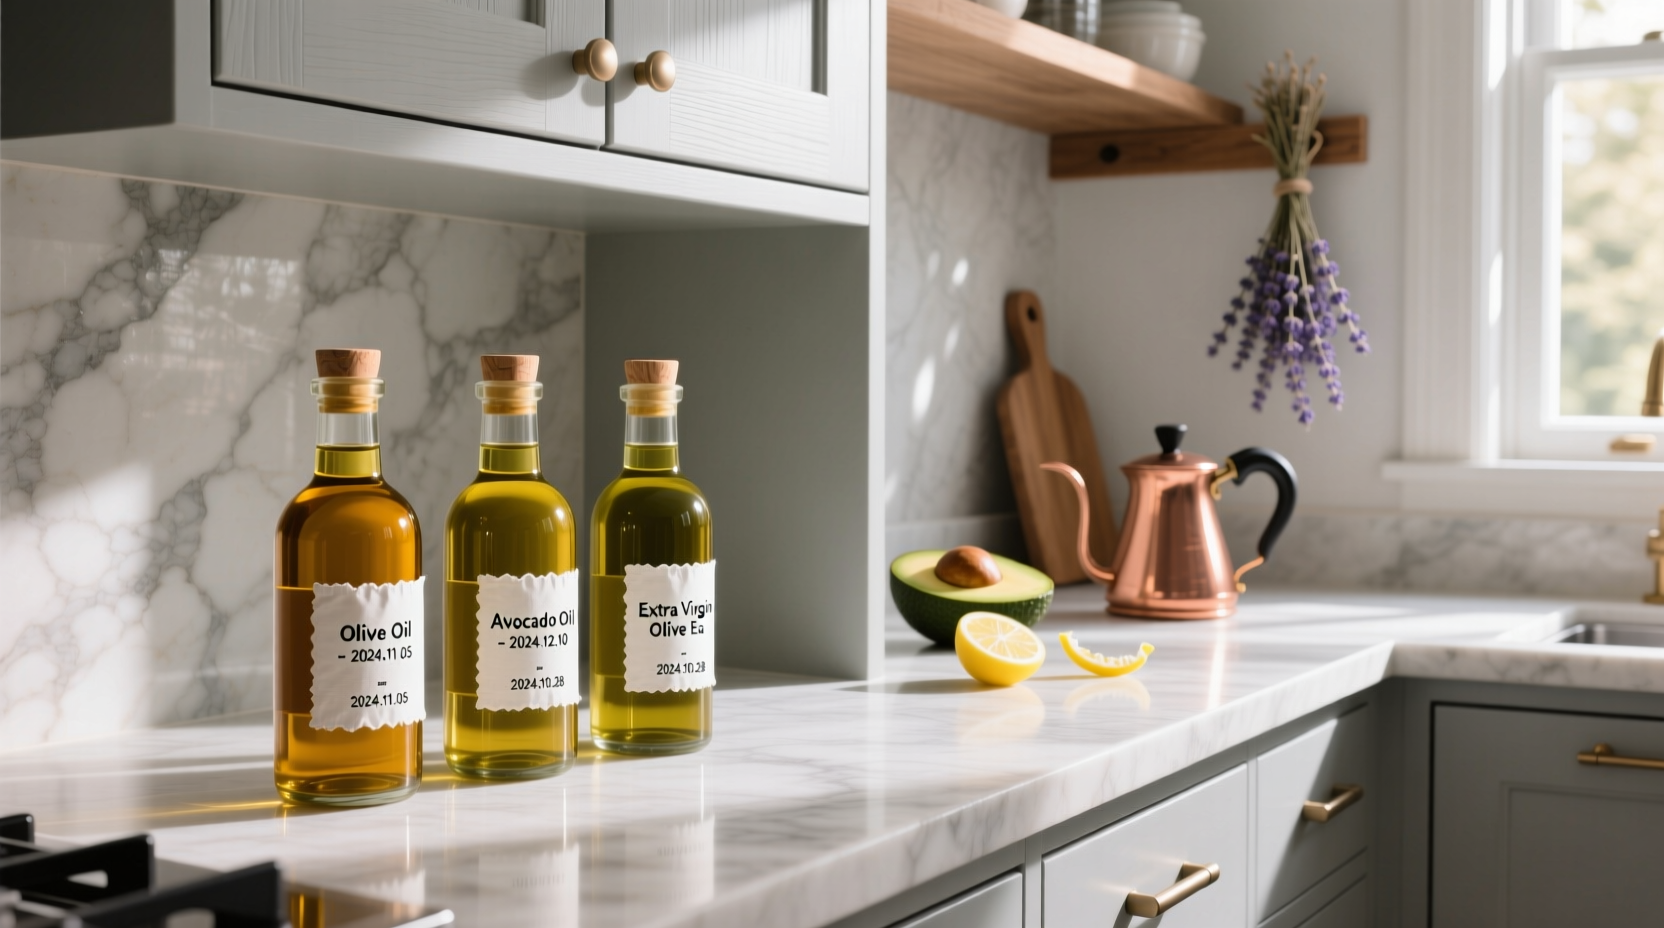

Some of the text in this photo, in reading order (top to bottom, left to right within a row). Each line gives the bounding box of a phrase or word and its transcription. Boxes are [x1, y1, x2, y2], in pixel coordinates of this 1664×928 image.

[639, 600, 712, 619] Extra Virgin
[490, 609, 575, 629] Avocado Oil
[340, 620, 411, 642] Olive Oil
[649, 621, 686, 637] Olive
[509, 633, 568, 649] 2024.12.10
[350, 692, 408, 708] 2024.11.05
